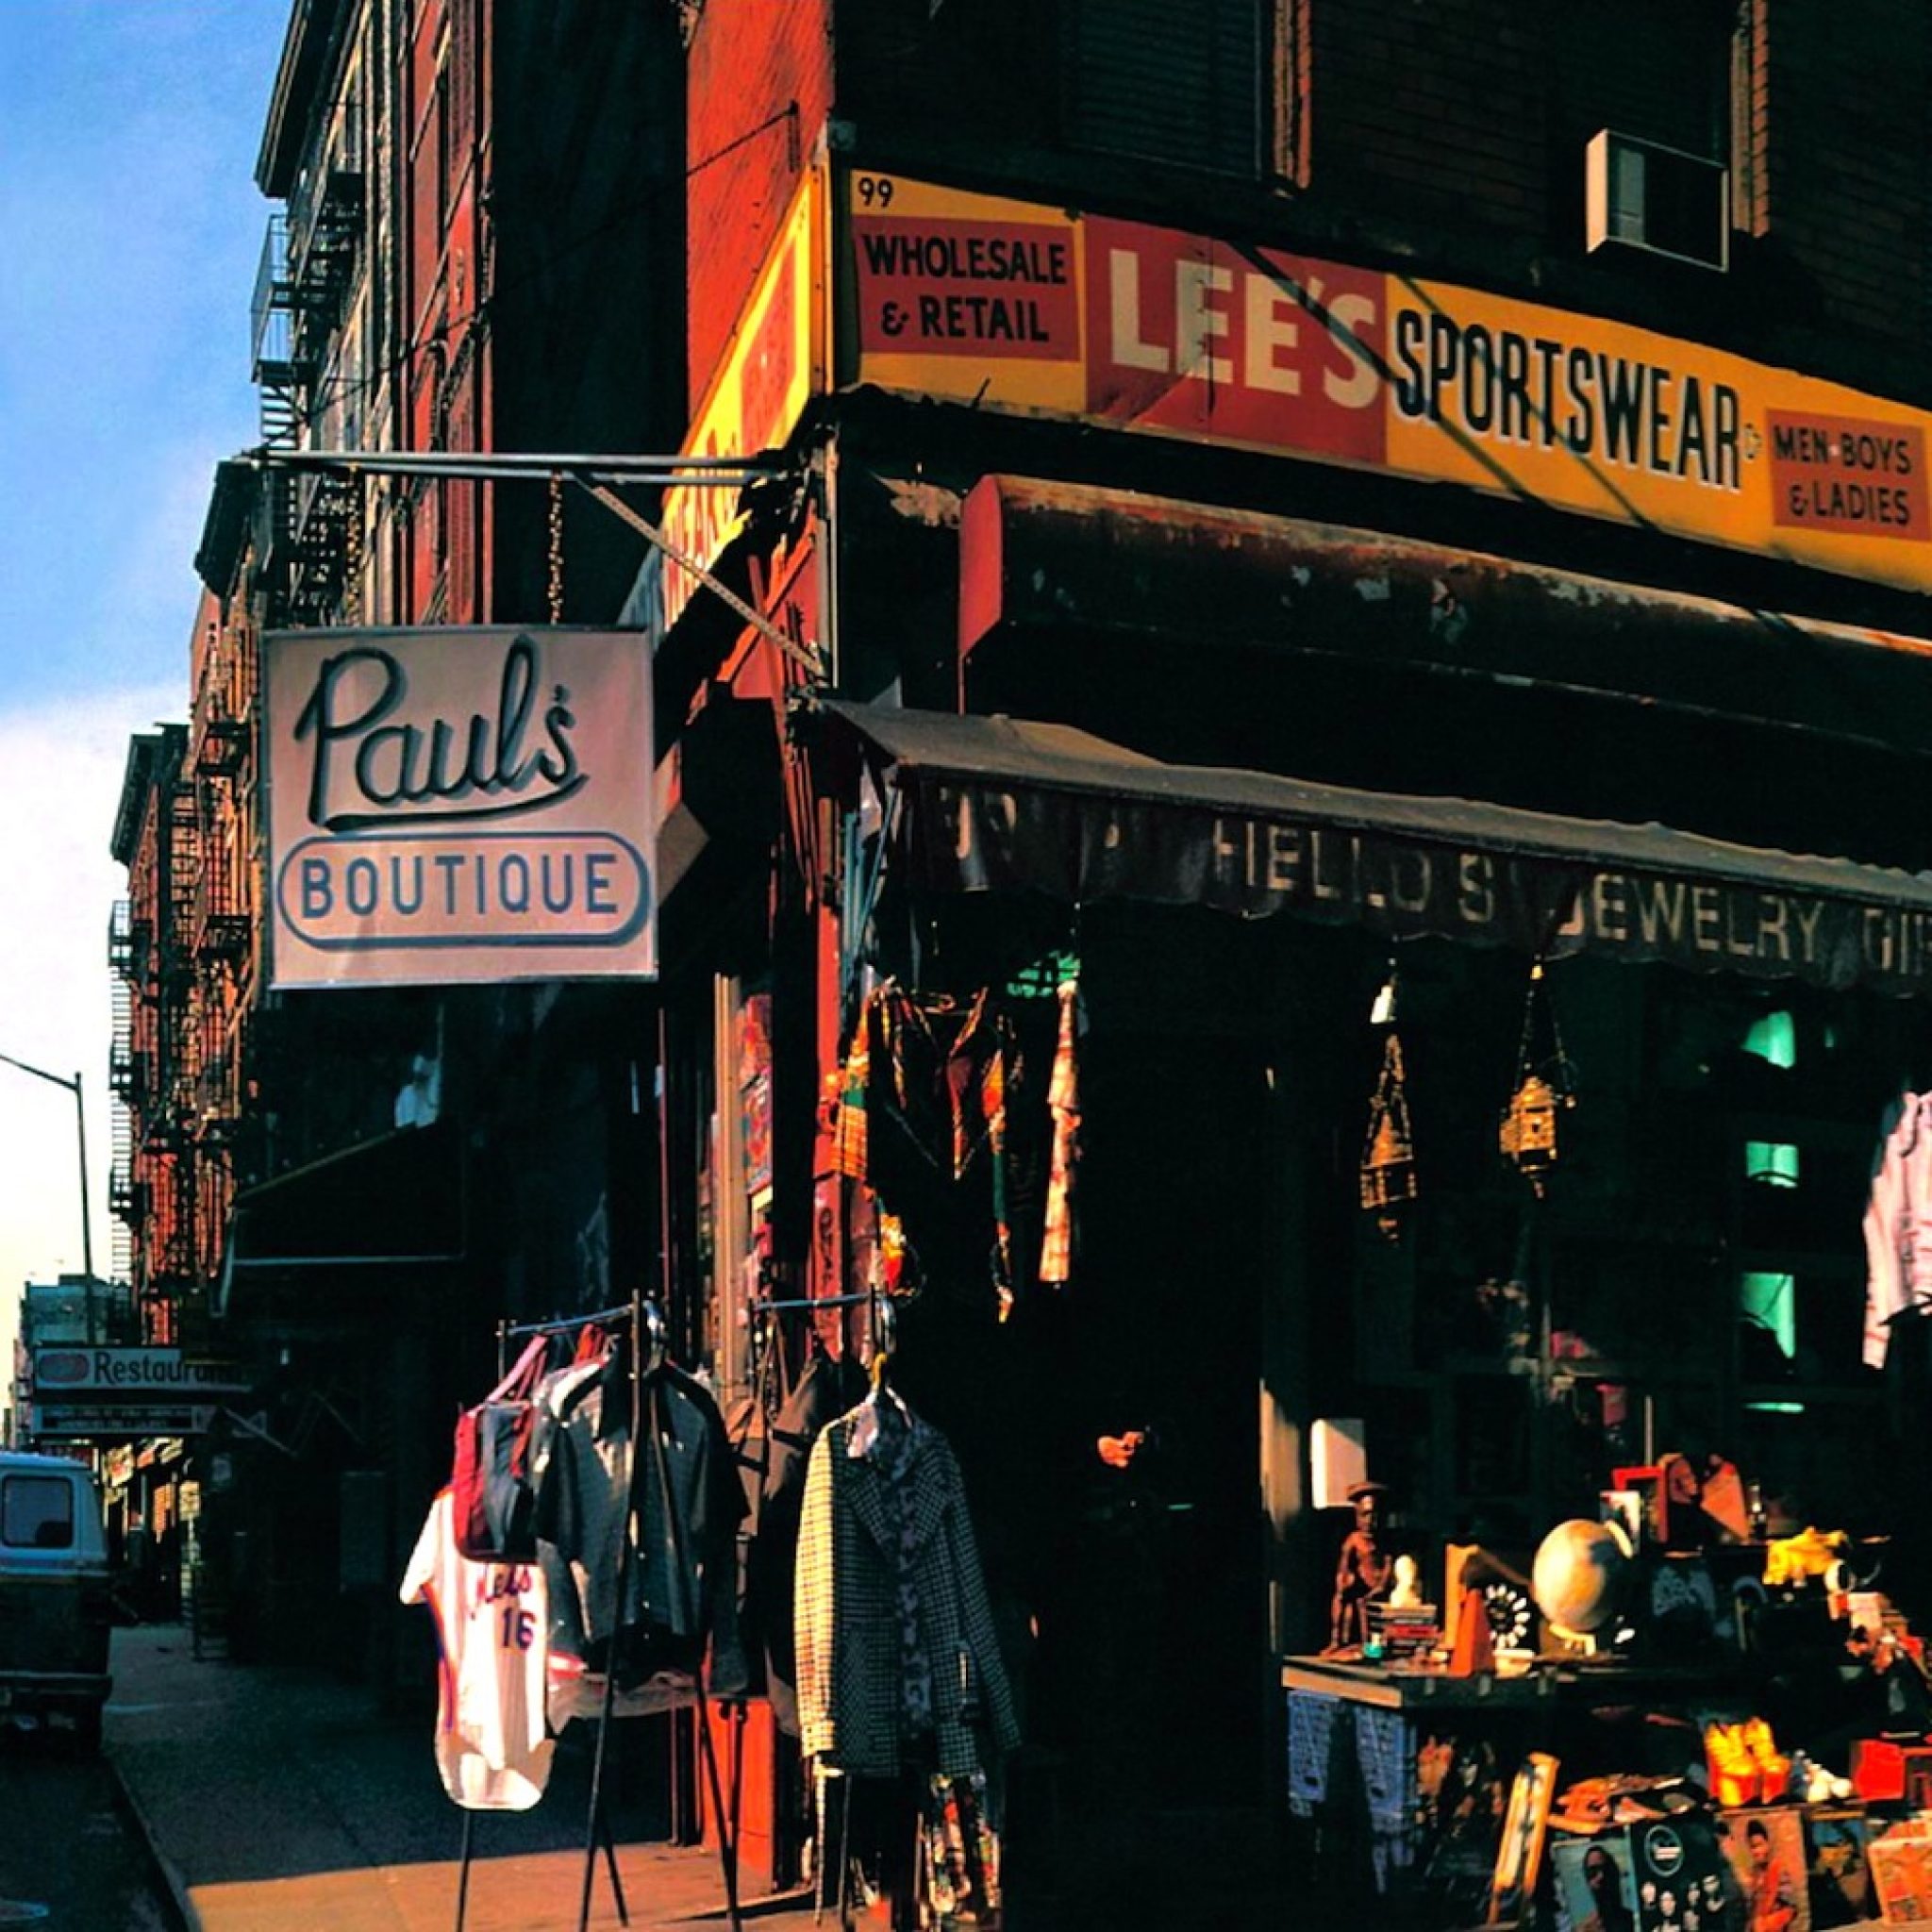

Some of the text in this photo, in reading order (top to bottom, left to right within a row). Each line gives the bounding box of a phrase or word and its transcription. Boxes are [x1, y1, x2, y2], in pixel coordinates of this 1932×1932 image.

[858, 176, 893, 208] 99
[860, 232, 1067, 285] WHOLESALE
[880, 295, 1049, 342] & RETAIL
[1109, 248, 1742, 492] LEE'S SPORTSWEAR
[1813, 484, 1910, 526] LADIES
[293, 634, 590, 832] Paul's
[301, 853, 619, 919] BOUTIQUE
[94, 1351, 228, 1384] Restaura
[503, 1607, 536, 1650] 16
